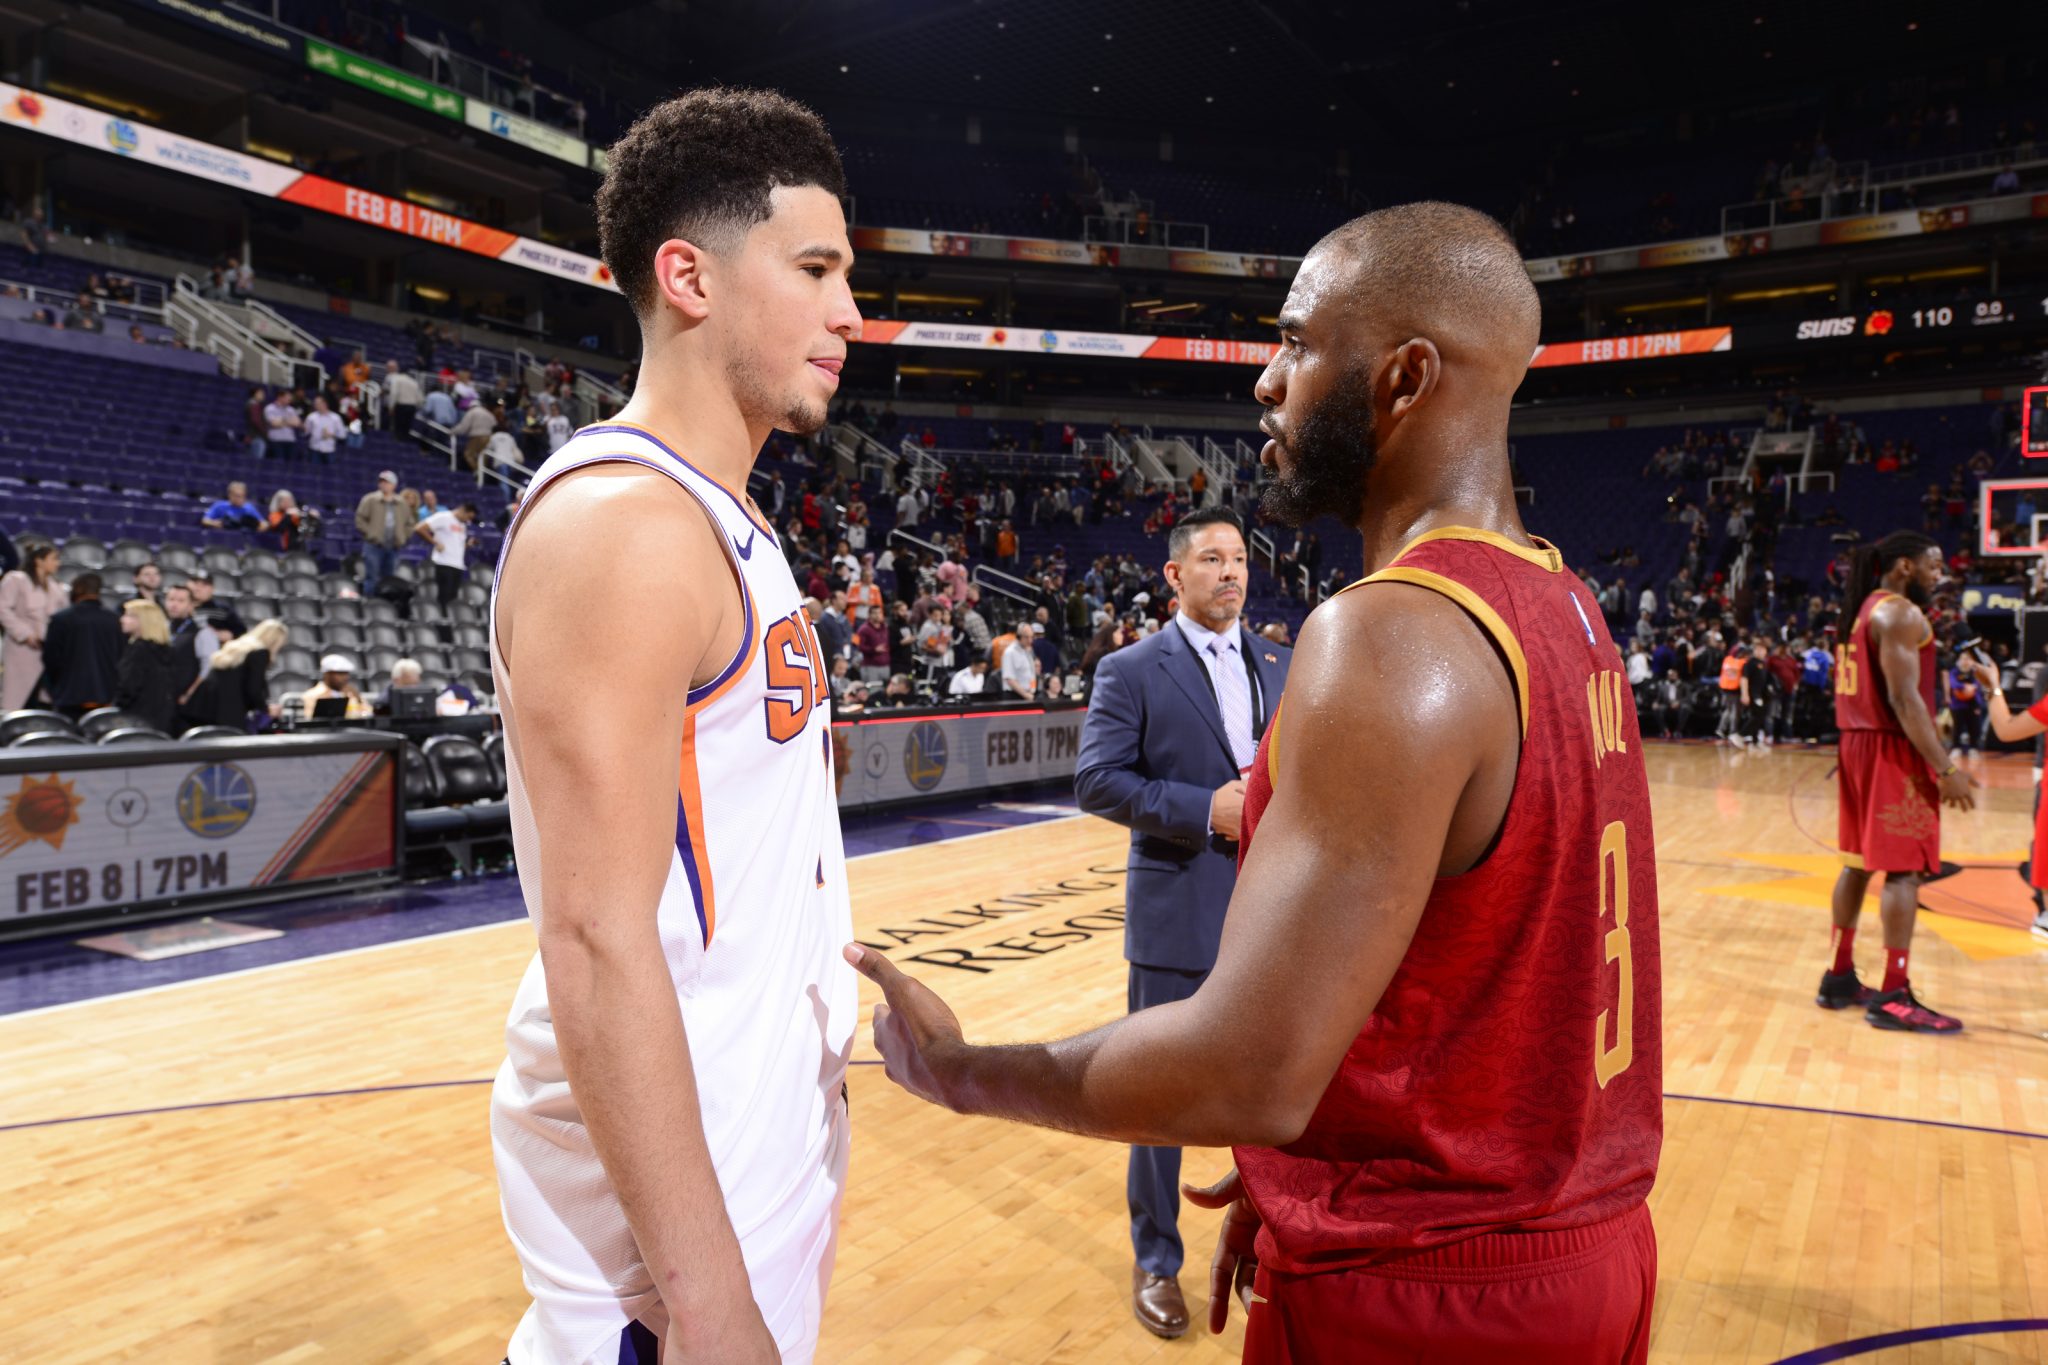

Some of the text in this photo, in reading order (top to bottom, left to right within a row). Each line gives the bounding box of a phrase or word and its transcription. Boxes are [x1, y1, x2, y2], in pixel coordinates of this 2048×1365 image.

[345, 188, 461, 247] FEB 8 7PM
[1796, 306, 1953, 341] SUNS 110
[1186, 339, 1271, 365] FEB 8 7PM
[1582, 331, 1681, 363] FEB 8 7PM
[987, 724, 1079, 767] FEB 8 7PM
[16, 850, 229, 914] FEB 8 7PM
[1594, 819, 1634, 1090] 3
